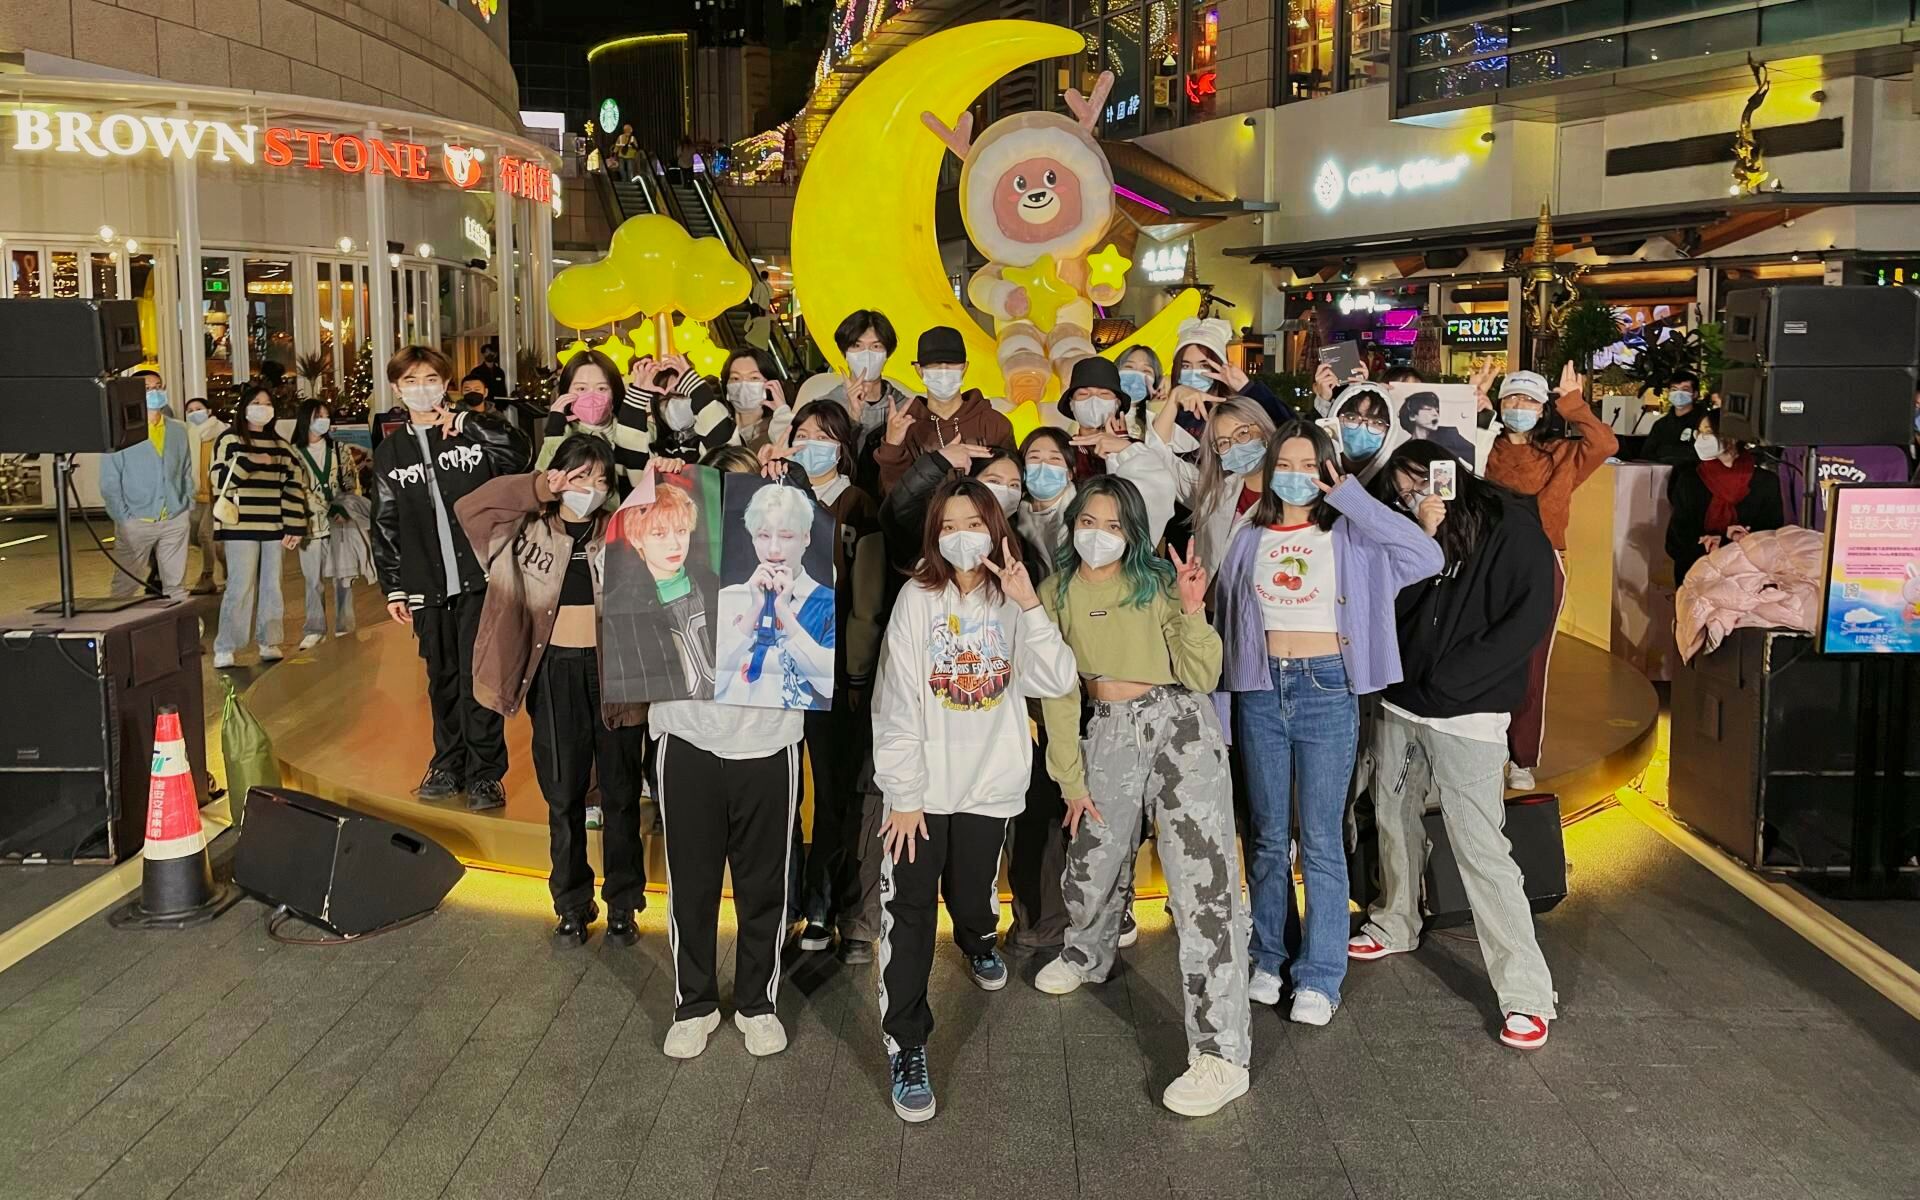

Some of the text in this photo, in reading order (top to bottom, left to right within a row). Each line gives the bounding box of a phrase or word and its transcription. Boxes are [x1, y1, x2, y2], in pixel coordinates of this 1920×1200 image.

[12, 109, 430, 179] BROWN STONE
[1447, 317, 1509, 336] FRUITS
[1255, 584, 1277, 602] NICE
[1296, 586, 1320, 605] MEET
